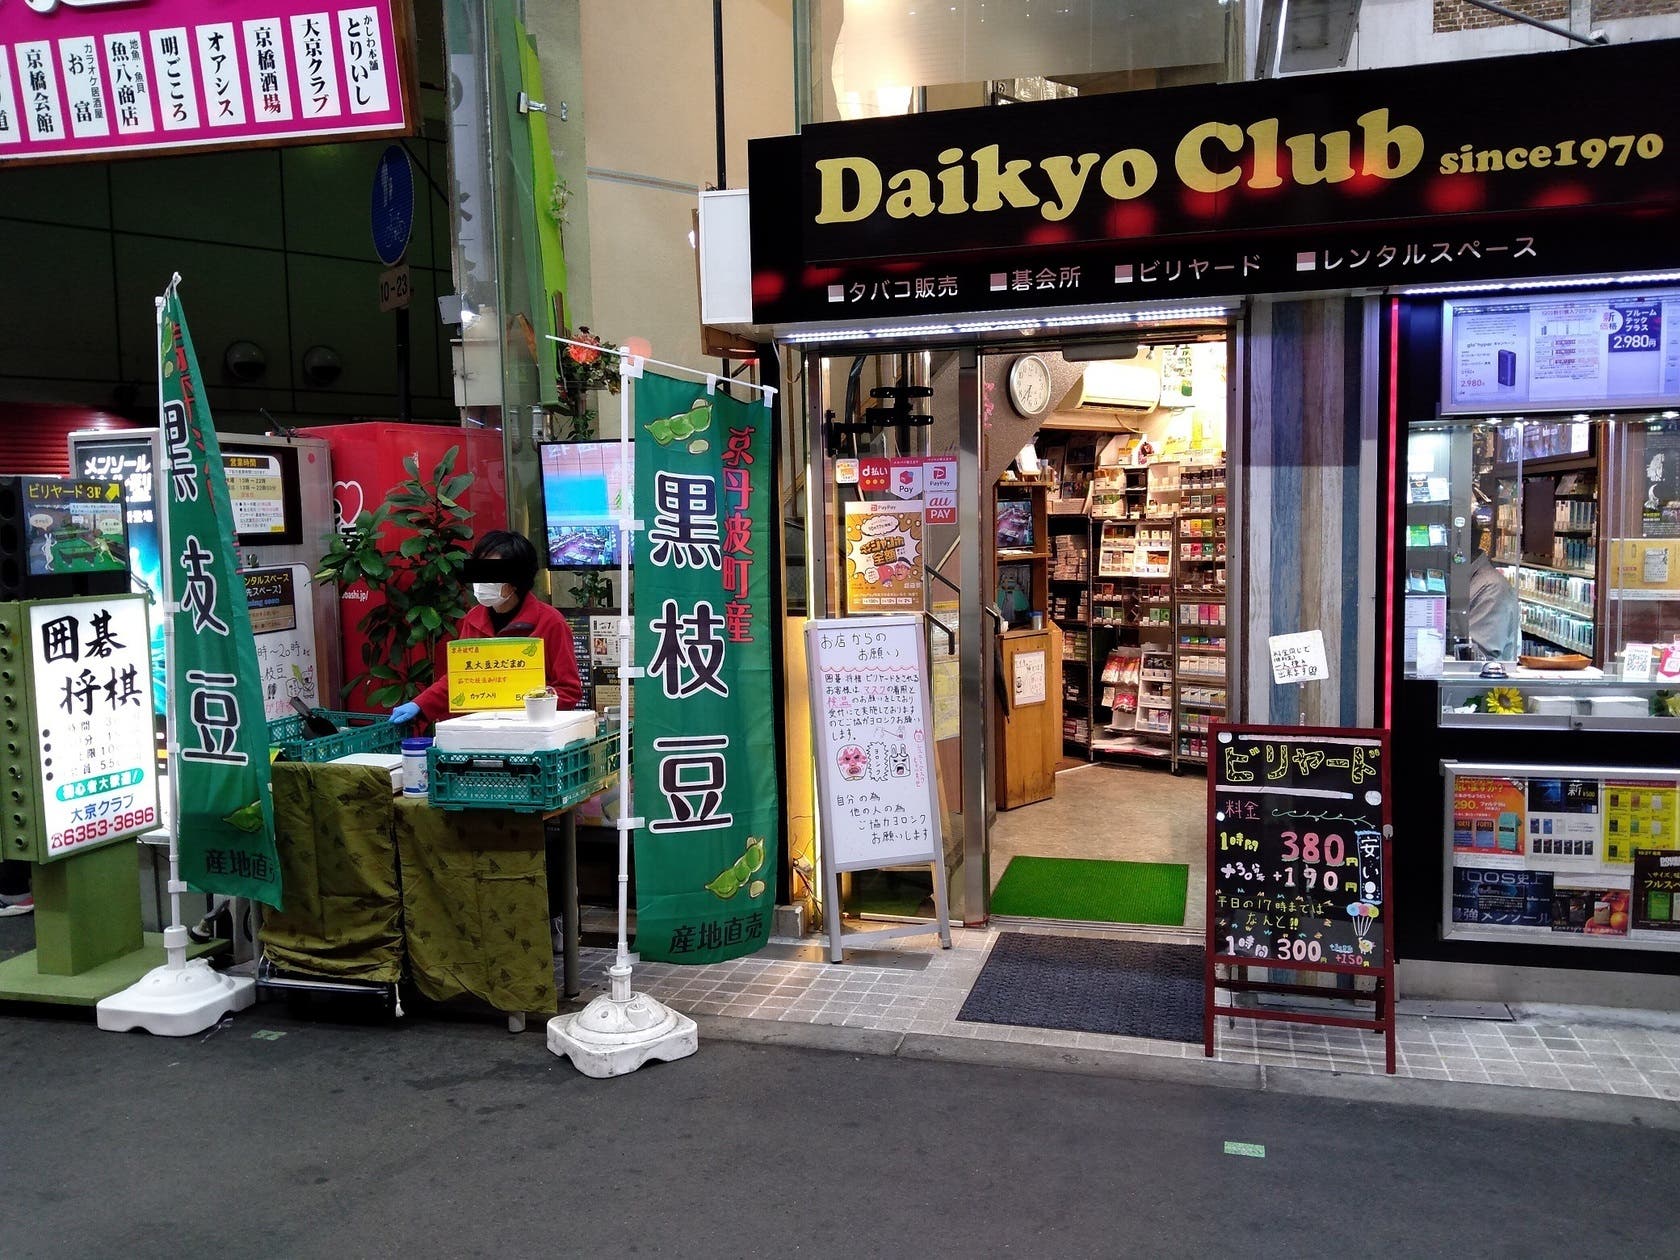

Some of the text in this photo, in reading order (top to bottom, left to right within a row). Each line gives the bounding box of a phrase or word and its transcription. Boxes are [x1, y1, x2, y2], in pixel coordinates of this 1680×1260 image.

[207, 32, 234, 118] オアシス
[255, 27, 282, 114] 京橋酒場
[301, 19, 329, 114] 大京クラブ
[348, 17, 371, 106] とりいし
[25, 49, 54, 132] 京橋会館
[84, 44, 104, 119] カラオケ居酒屋
[111, 41, 139, 127] 魚八商店
[160, 36, 188, 122] 明ごころ
[815, 108, 1664, 225] Daikyo Club since1970
[849, 236, 1537, 303] タバコ販売 碁会所 ビリヤード レンタルスペース
[380, 275, 409, 302] 10-23
[84, 454, 151, 475] メンソール
[862, 465, 888, 477] d払い
[29, 484, 83, 499] ビリヤード
[900, 486, 914, 494] Pay
[929, 497, 952, 507] au
[930, 510, 951, 519] PAY
[721, 427, 756, 643] 京丹波町産
[42, 609, 127, 663] 囲碁
[821, 632, 887, 650] お店からの
[465, 659, 526, 670] 黒大豆えだまめ
[647, 470, 733, 834] 黒枝豆
[858, 647, 900, 661] お願い
[60, 663, 143, 716] 将棋
[470, 692, 497, 700] カップ入り
[826, 685, 860, 696] お客様は
[1225, 744, 1381, 784] ビリヤード
[1568, 783, 1583, 796] 新
[71, 793, 134, 824] 大京クラブ
[850, 804, 906, 817] 他の人の為
[859, 814, 926, 830] ご協力ヨロシク
[1225, 799, 1261, 820] 料金
[64, 806, 154, 846] 6353-3696
[872, 828, 928, 845] お願いします
[1219, 832, 1259, 851] 1時間
[206, 849, 275, 884] 産地直
[1217, 895, 1324, 914] 平日の17時までは
[670, 912, 763, 954] 産地直売
[1225, 935, 1269, 958] 1時間
